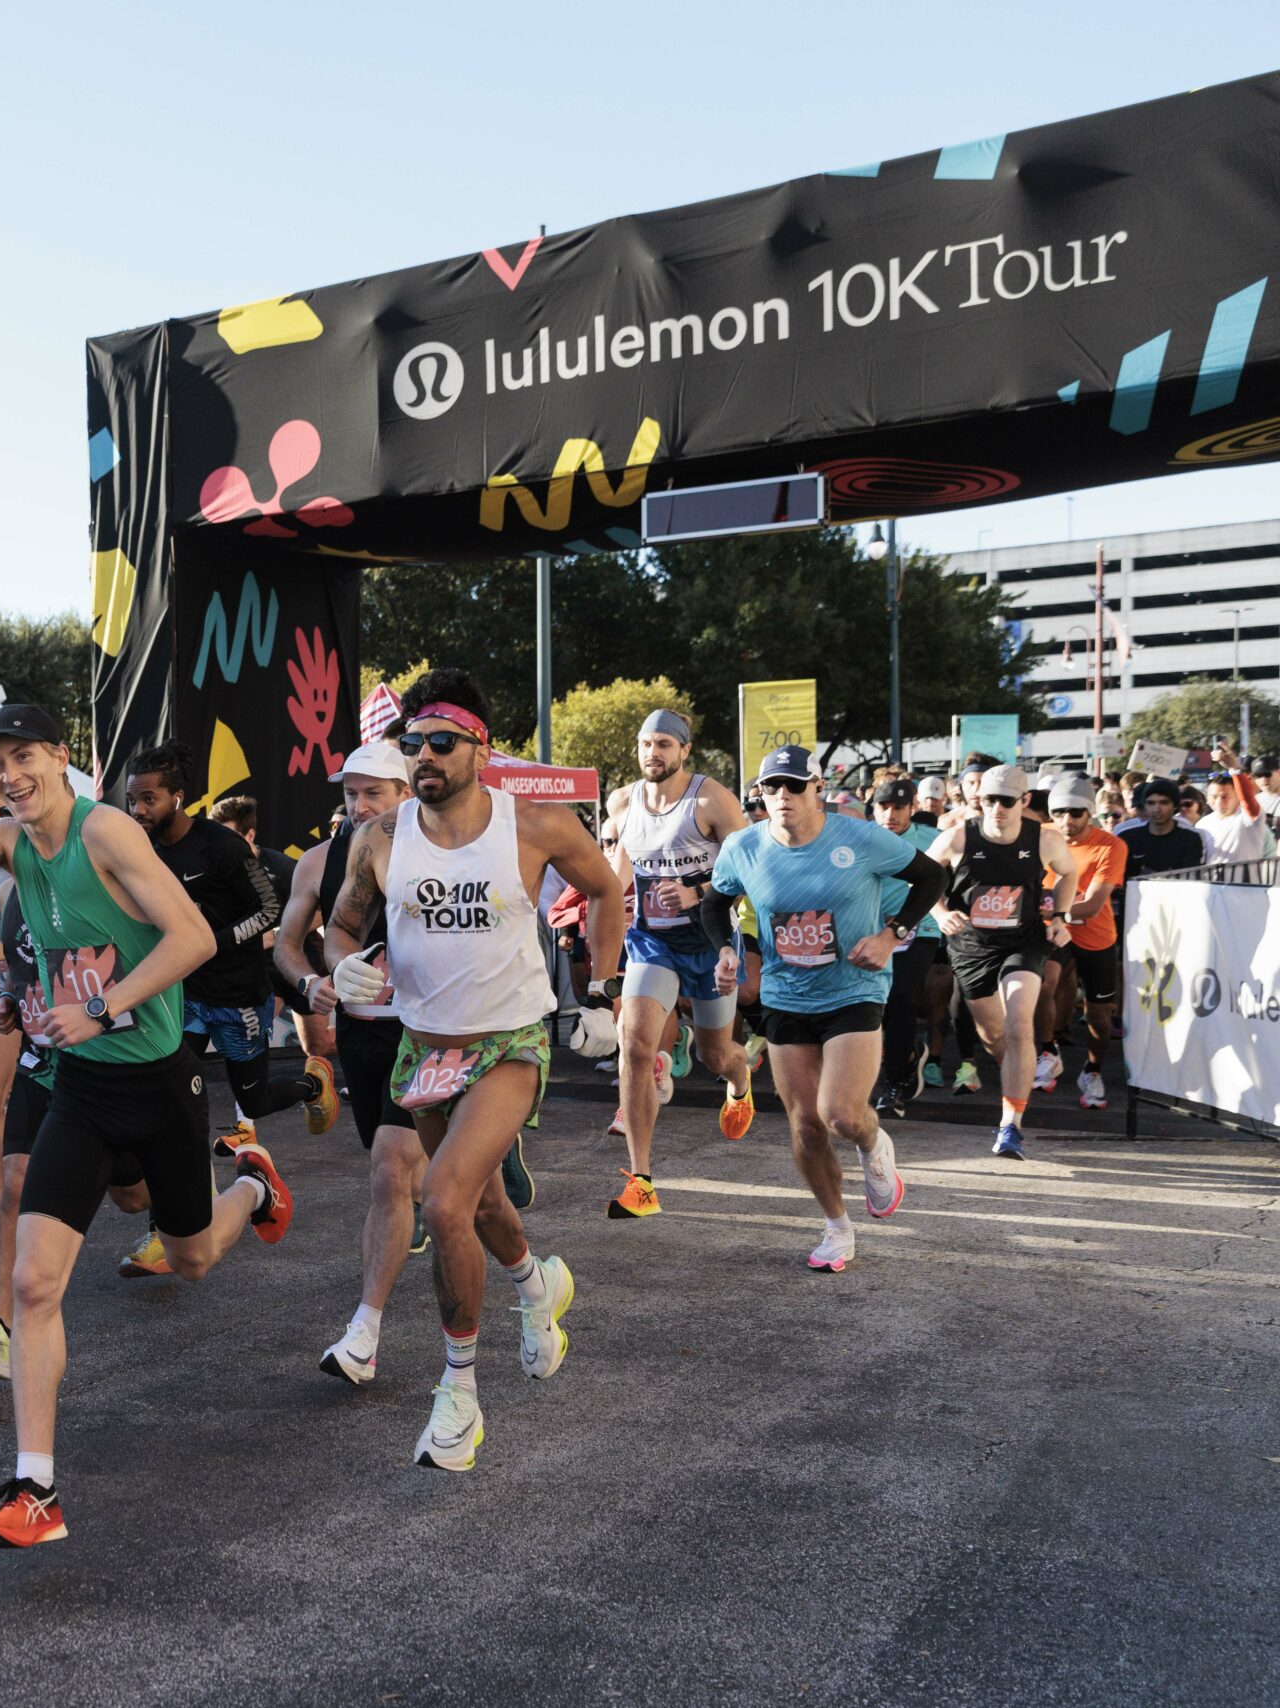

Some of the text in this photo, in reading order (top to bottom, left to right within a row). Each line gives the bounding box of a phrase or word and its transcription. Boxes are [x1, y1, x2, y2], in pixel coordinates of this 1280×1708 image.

[484, 229, 1129, 396] lululemon 10K Tour
[759, 730, 802, 749] 7:00
[501, 777, 575, 794] DMSESPORTS.COM
[658, 852, 709, 868] HERONS
[451, 881, 491, 904] 10K
[979, 895, 1014, 913] 864
[420, 907, 491, 929] TOUR
[774, 923, 835, 946] 3935
[66, 968, 103, 1001] 10
[19, 998, 47, 1023] 34
[409, 1066, 472, 1097] 4025
